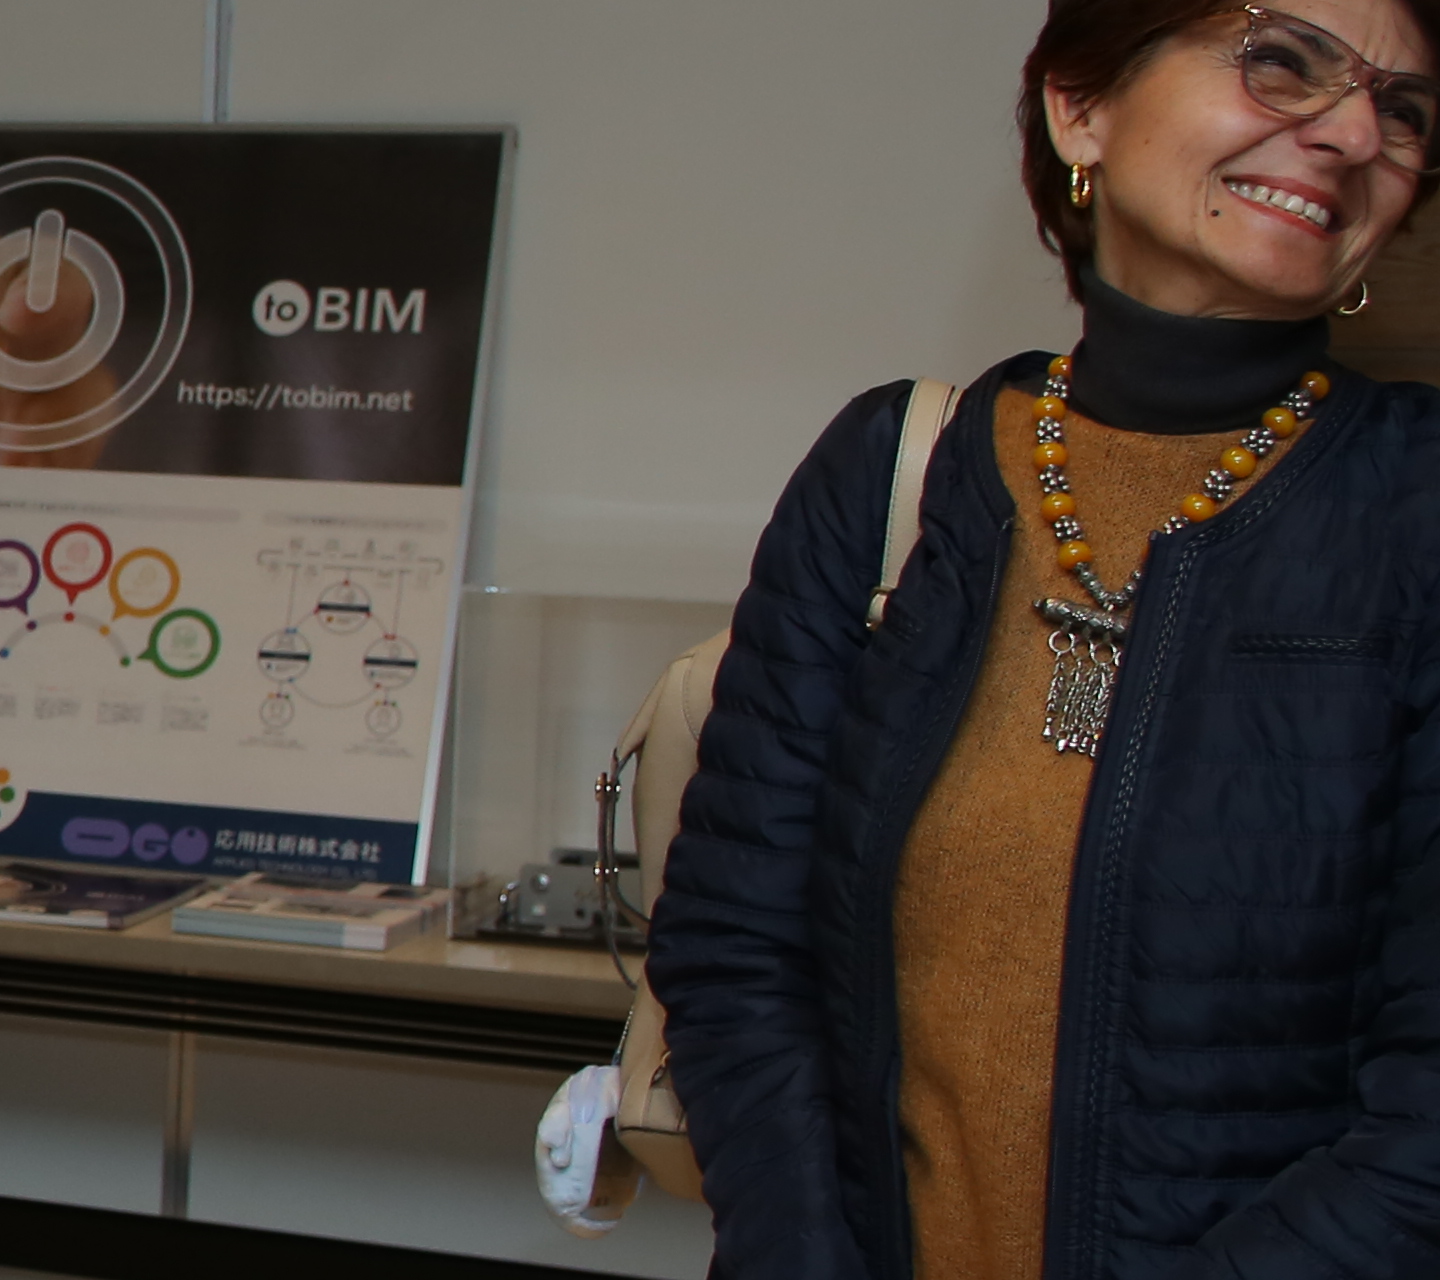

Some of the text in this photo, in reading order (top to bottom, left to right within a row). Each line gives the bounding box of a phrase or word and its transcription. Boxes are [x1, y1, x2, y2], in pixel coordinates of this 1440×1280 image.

[177, 379, 414, 416] https://tobim.net
[214, 829, 382, 864] 応用技術株式会社
